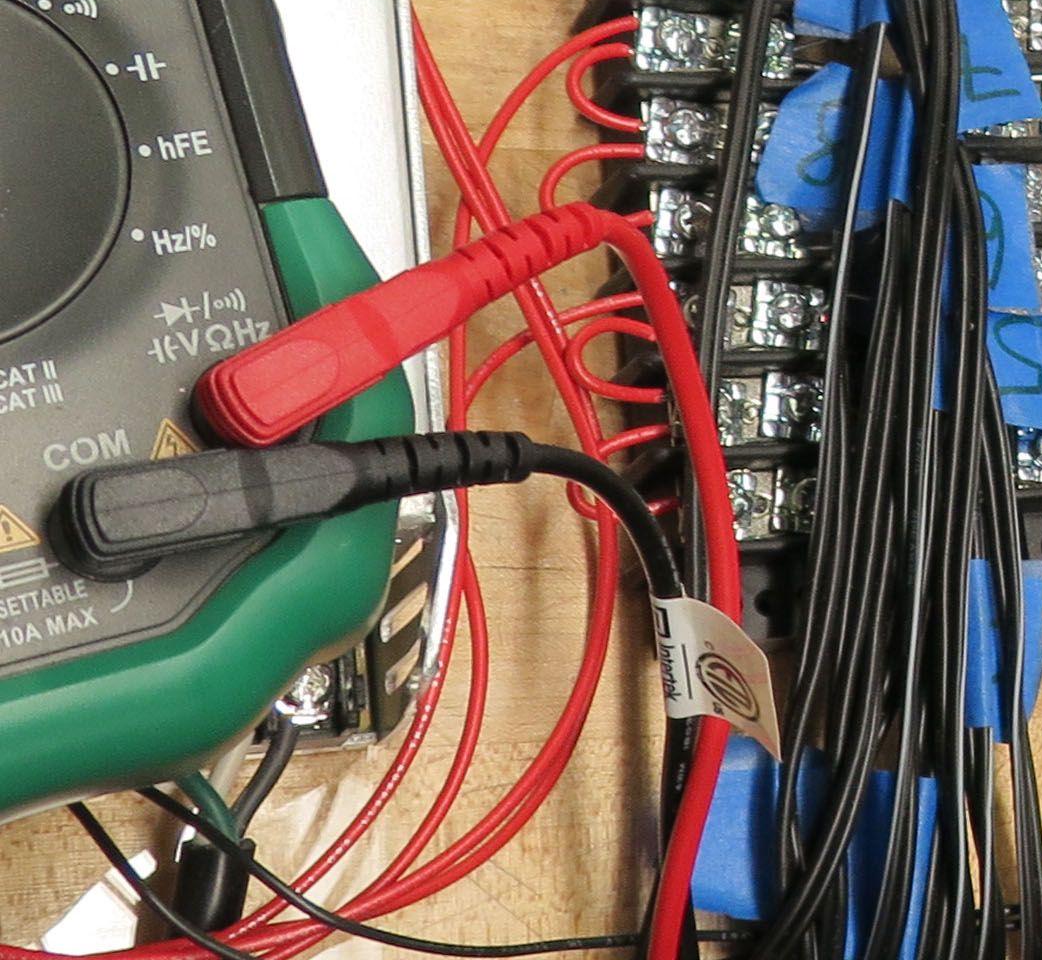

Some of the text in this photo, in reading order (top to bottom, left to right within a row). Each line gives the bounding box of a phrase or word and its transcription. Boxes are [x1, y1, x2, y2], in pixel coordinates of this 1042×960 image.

[157, 130, 213, 161] hFE
[152, 223, 217, 256] Hz/%
[42, 360, 58, 380] II
[42, 383, 64, 404] III
[43, 429, 132, 471] COM
[0, 579, 88, 619] SETTABLE
[0, 606, 99, 648] 10A MAX
